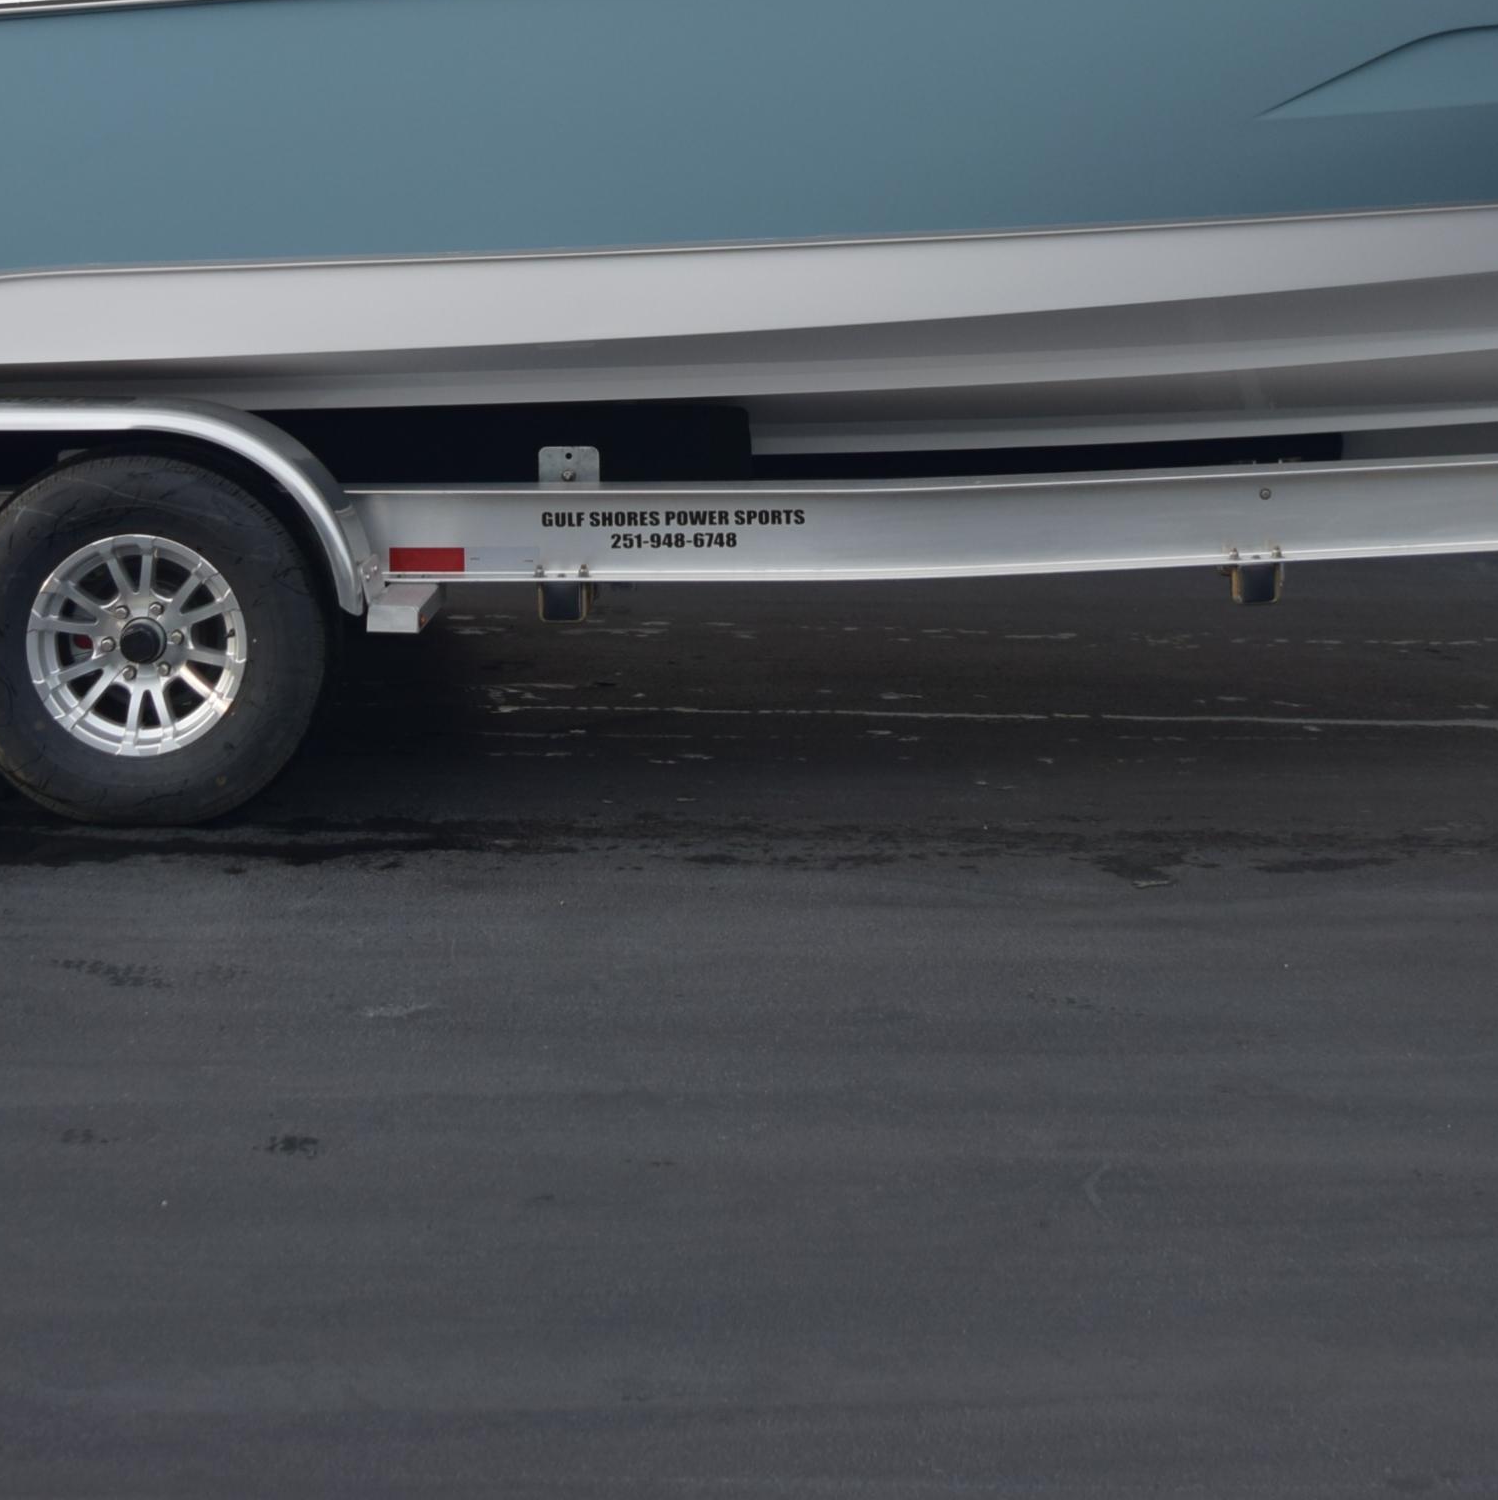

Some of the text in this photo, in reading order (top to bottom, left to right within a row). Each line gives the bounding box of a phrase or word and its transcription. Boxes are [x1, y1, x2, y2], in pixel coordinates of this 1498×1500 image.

[541, 508, 806, 528] GULF SHORES POWER SPORTS
[610, 531, 738, 549] 251-948-6748
